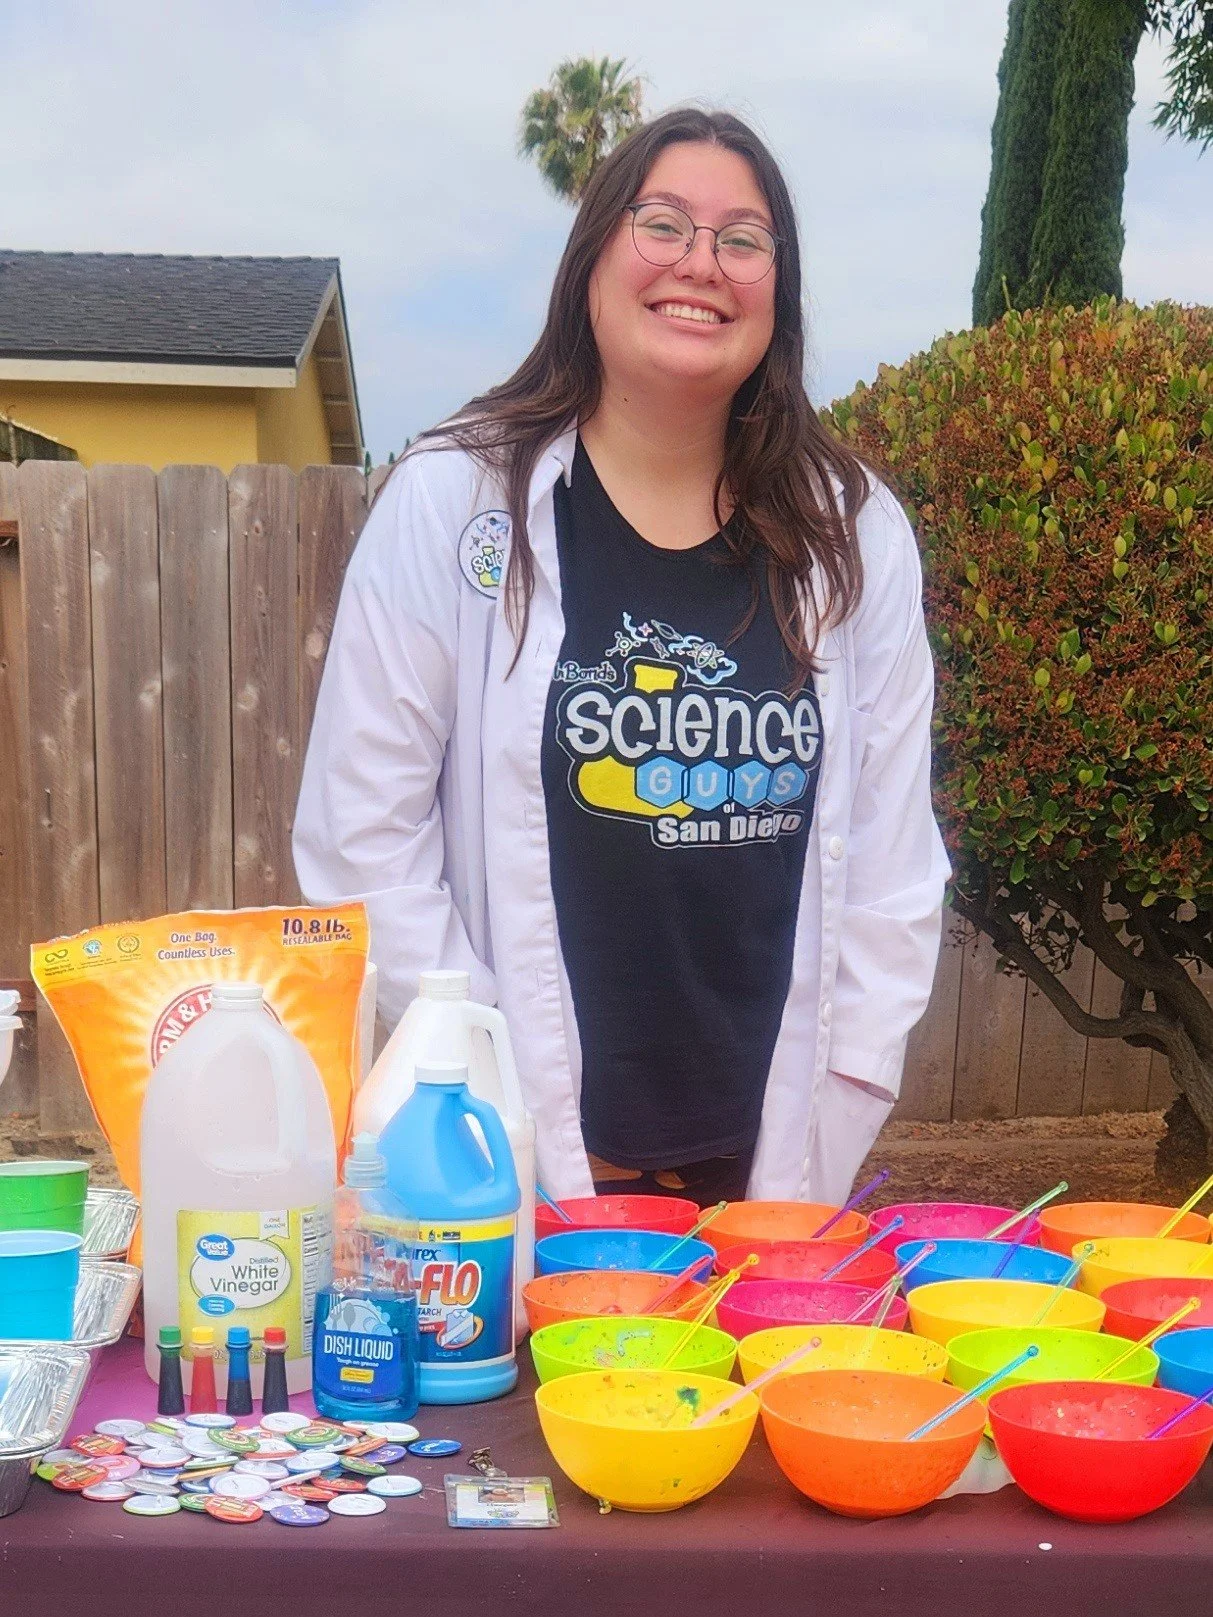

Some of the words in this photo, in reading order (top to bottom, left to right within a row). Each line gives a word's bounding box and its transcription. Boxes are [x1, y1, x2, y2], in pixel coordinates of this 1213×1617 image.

[565, 690, 820, 764] Science
[649, 766, 796, 799] GUYS
[723, 802, 735, 814] of
[657, 817, 721, 843] San
[729, 813, 801, 841] Diego
[282, 918, 321, 935] 10.8
[325, 919, 351, 933] lb.
[170, 933, 191, 943] One
[194, 932, 217, 944] Bag.
[282, 934, 333, 946] RESEALABLE
[335, 932, 352, 941] BAG
[158, 948, 206, 960] Countless
[209, 946, 235, 957] Uses.
[159, 1017, 186, 1054] RM
[178, 1003, 198, 1022] &
[200, 1239, 228, 1251] Great
[231, 1265, 279, 1280] White
[210, 1277, 279, 1296] Vinegar
[417, 1307, 442, 1316] TARCH
[323, 1334, 352, 1357] DISH
[354, 1337, 394, 1361] LIQUID
